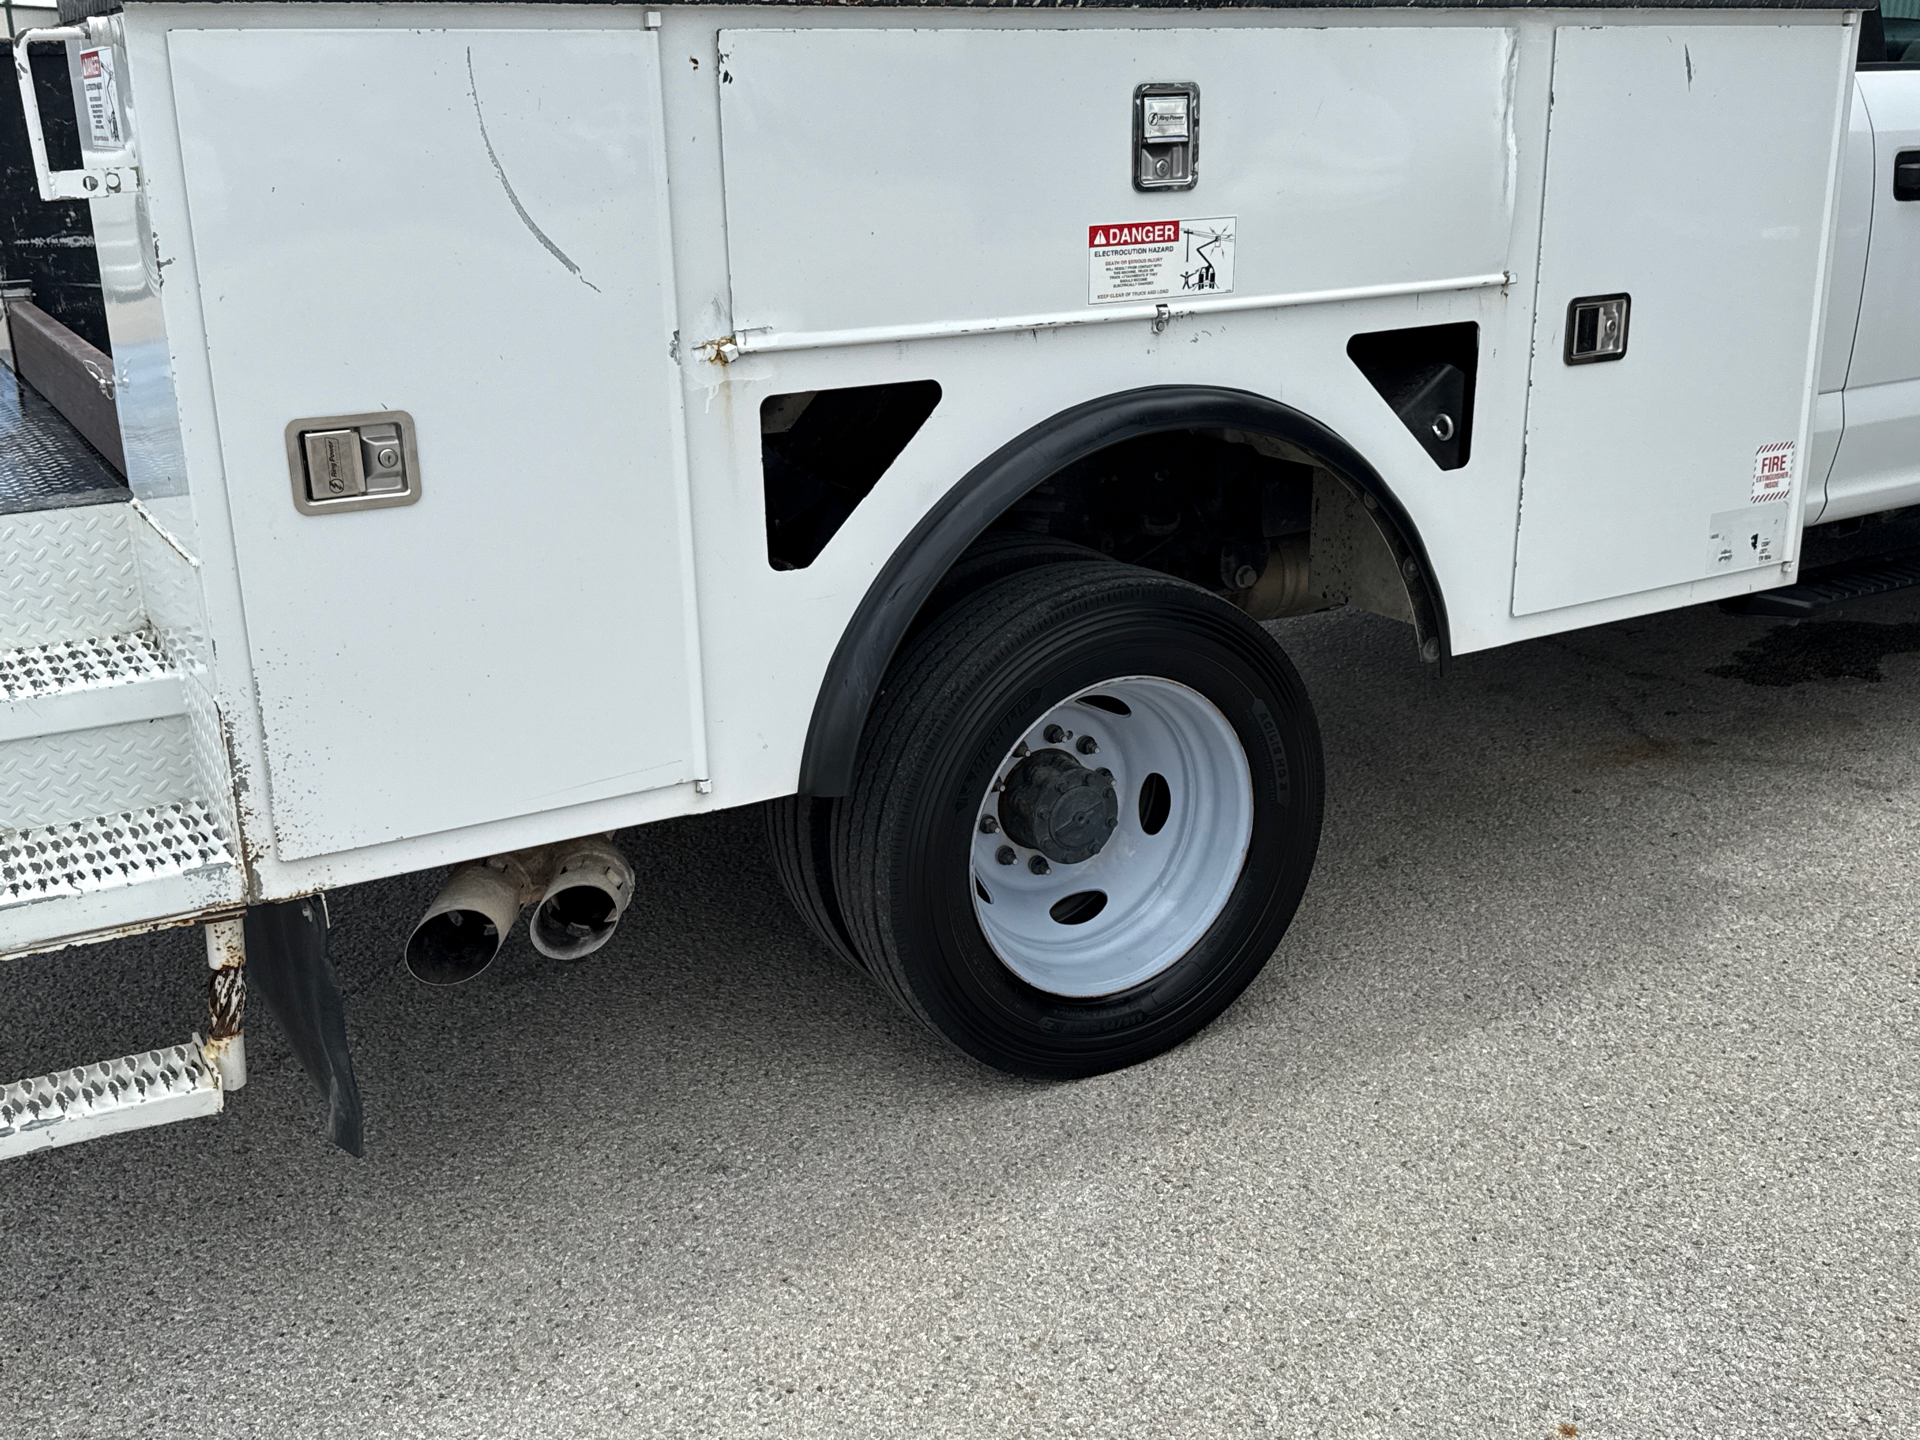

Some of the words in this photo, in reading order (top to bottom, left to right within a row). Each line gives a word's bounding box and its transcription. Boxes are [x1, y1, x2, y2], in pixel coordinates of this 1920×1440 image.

[1109, 225, 1174, 244] DANGER
[1094, 248, 1146, 257] ELECTROCUTION
[1761, 454, 1787, 474] FIRE
[1756, 471, 1788, 483] EXTINGUISHER
[1764, 480, 1779, 489] INSIDE
[970, 695, 1031, 777] MICHELIN
[1258, 712, 1282, 755] AGILIS
[1276, 758, 1286, 779] HD
